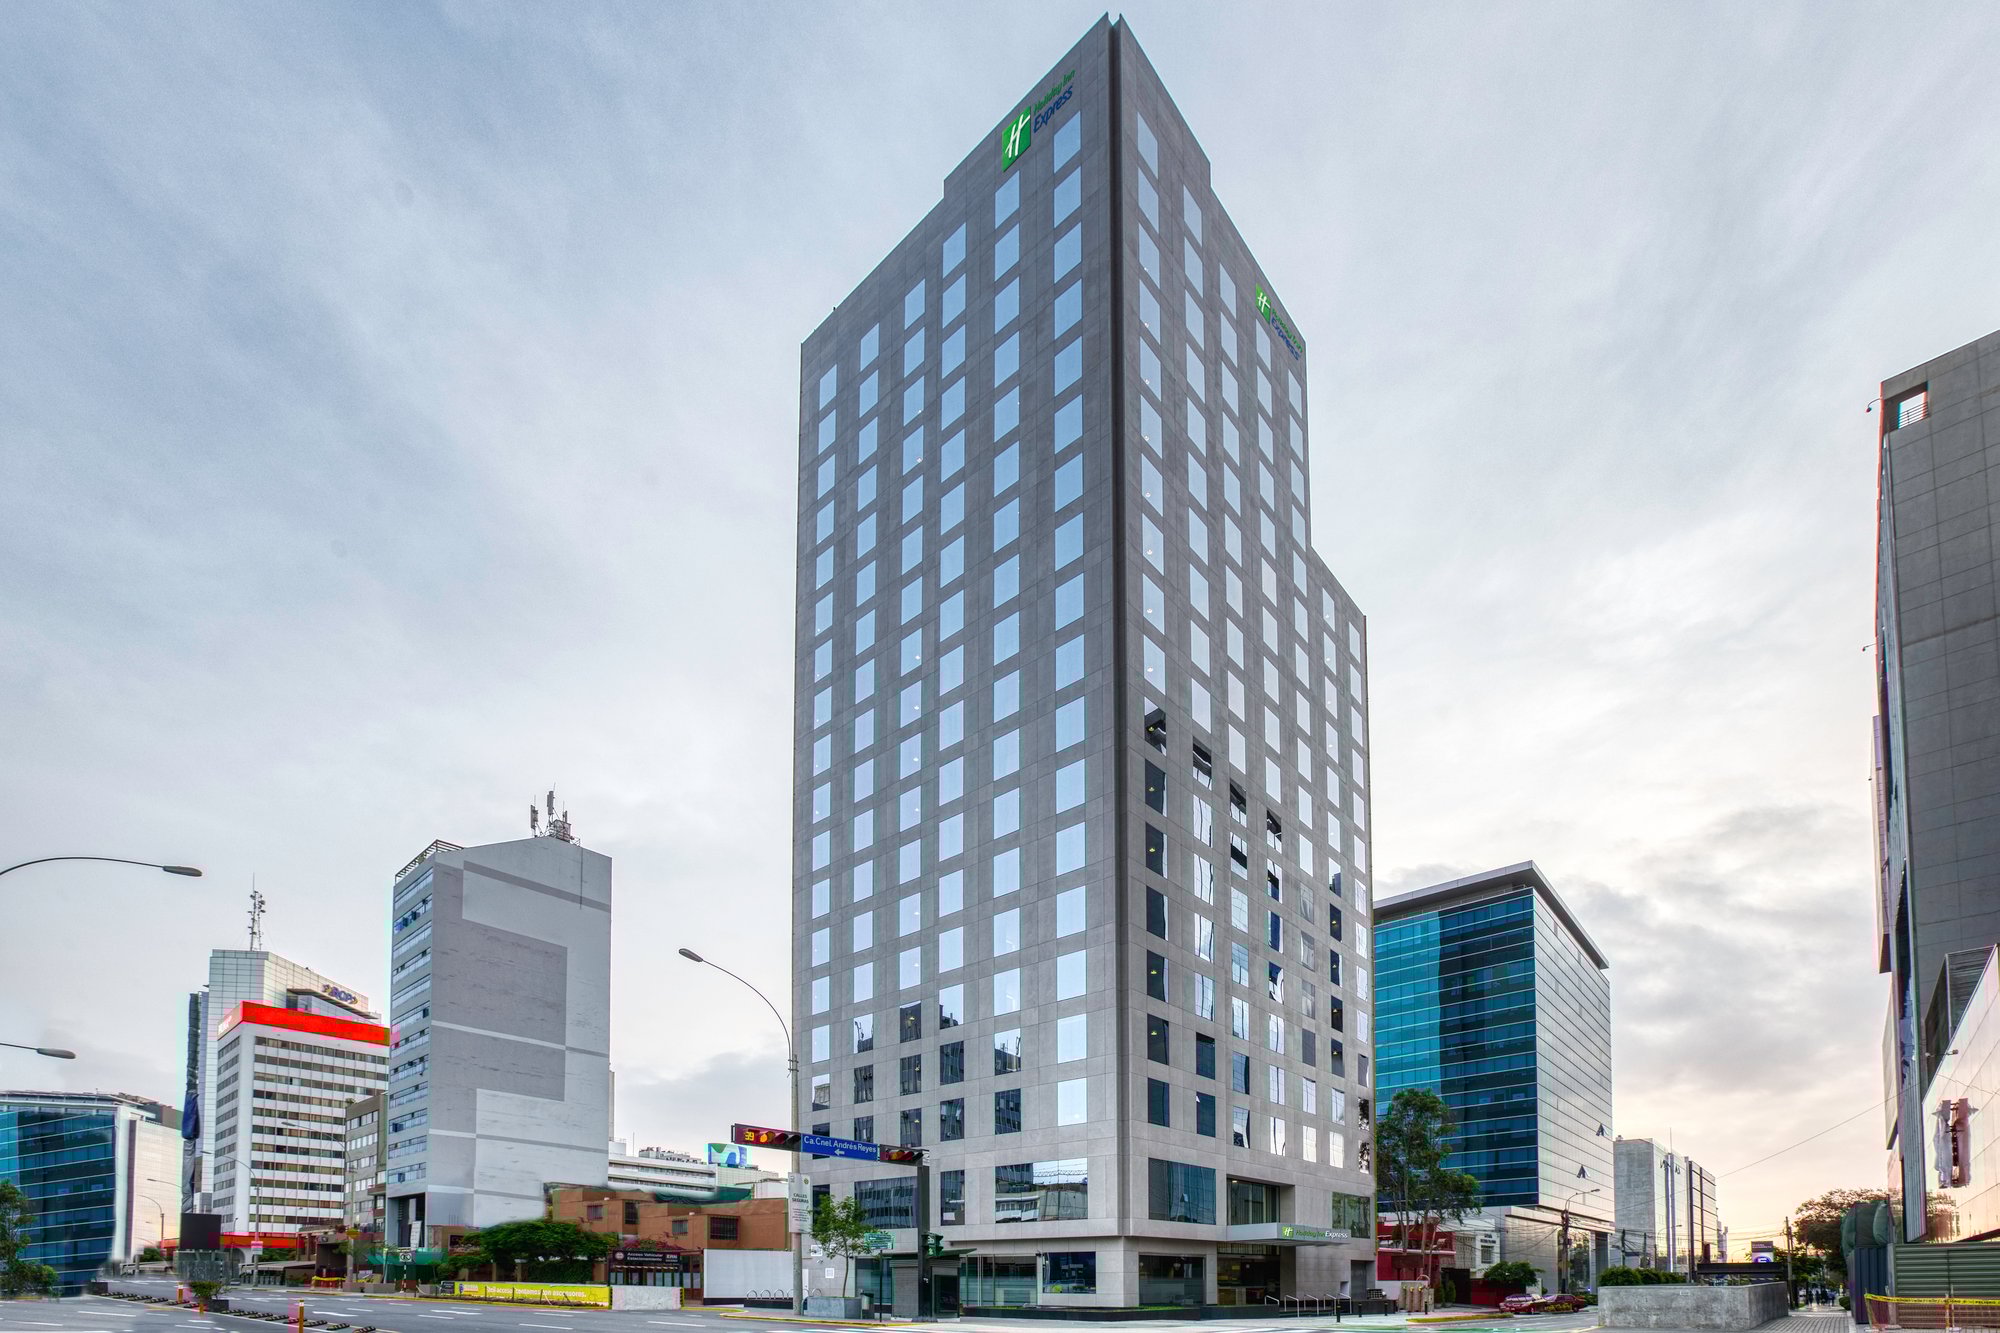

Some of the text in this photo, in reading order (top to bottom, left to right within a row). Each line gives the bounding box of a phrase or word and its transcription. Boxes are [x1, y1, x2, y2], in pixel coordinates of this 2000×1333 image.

[1033, 85, 1073, 133] Express
[833, 1140, 857, 1151] Andrés
[857, 1143, 877, 1153] Reyes
[1325, 1230, 1348, 1239] Express
